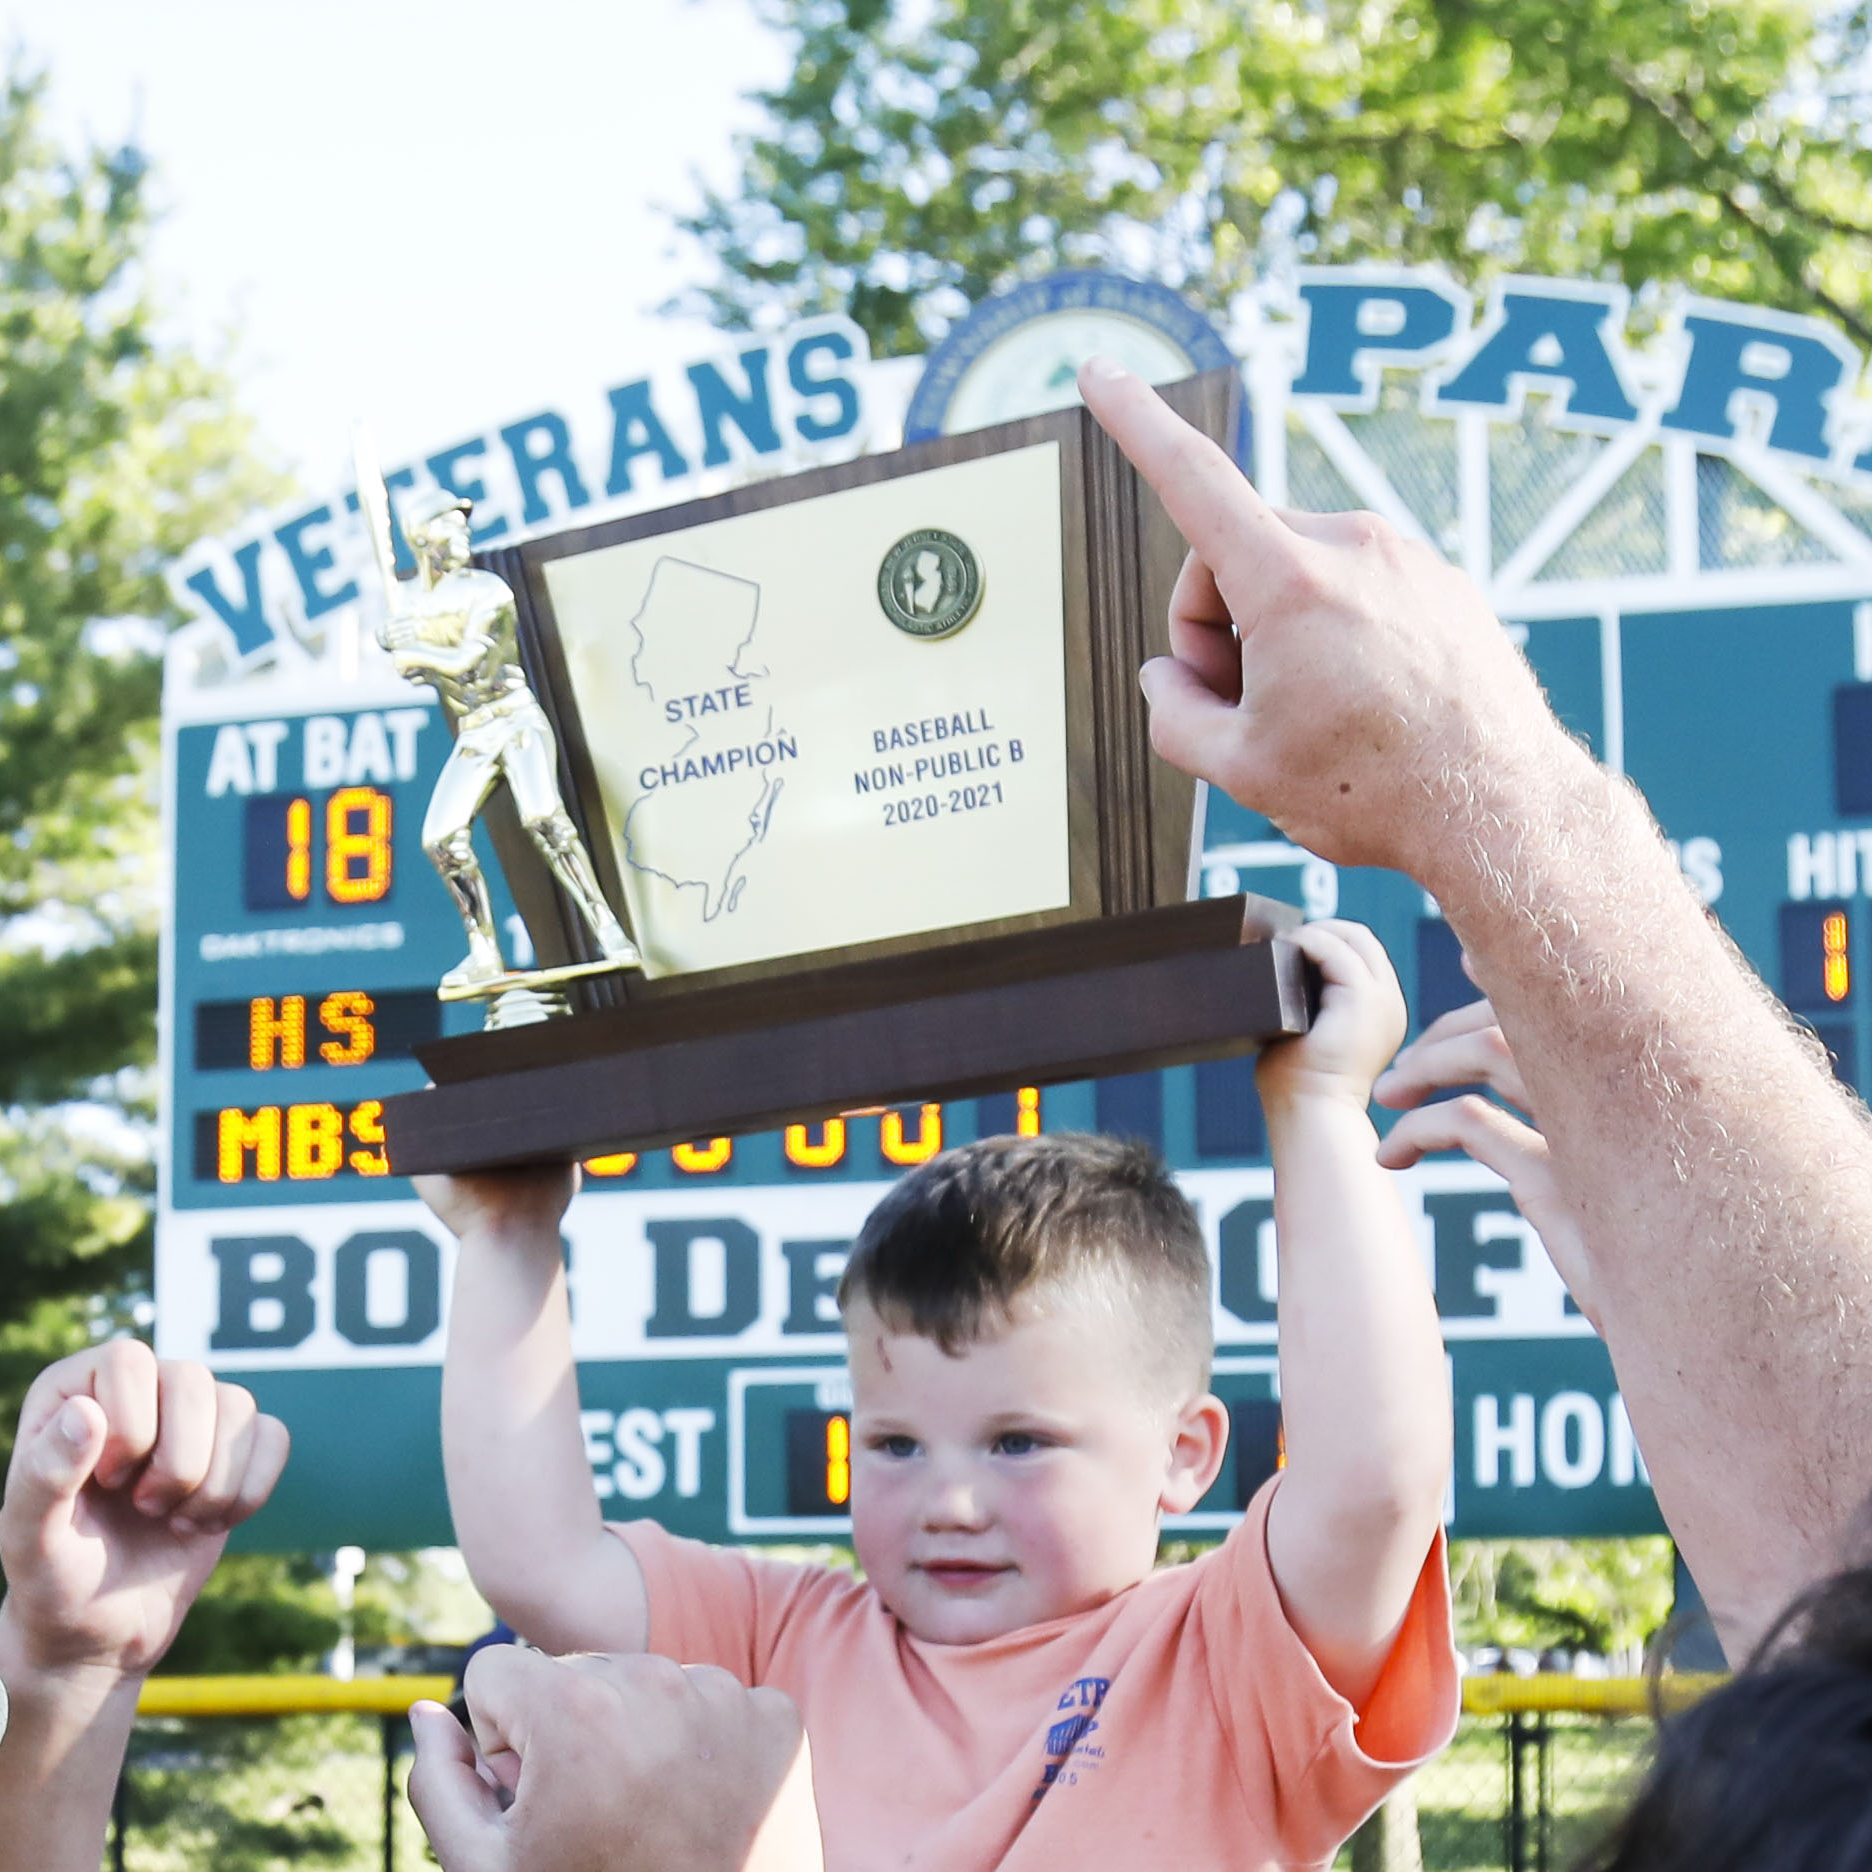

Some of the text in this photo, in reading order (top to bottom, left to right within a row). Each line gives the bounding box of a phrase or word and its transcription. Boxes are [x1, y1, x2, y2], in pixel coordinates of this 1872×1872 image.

[665, 684, 753, 723] STATE
[873, 708, 995, 753] BASEBALL
[206, 708, 429, 797] AT BAT
[640, 737, 798, 790] CHAMPION
[854, 739, 1025, 794] NON-PUBLIC B
[883, 781, 1004, 826] 2020-2021
[286, 786, 393, 903] 18
[249, 990, 375, 1071] HS
[218, 1100, 390, 1183] MBS
[210, 1230, 572, 1350] BO
[580, 1407, 716, 1500] EST
